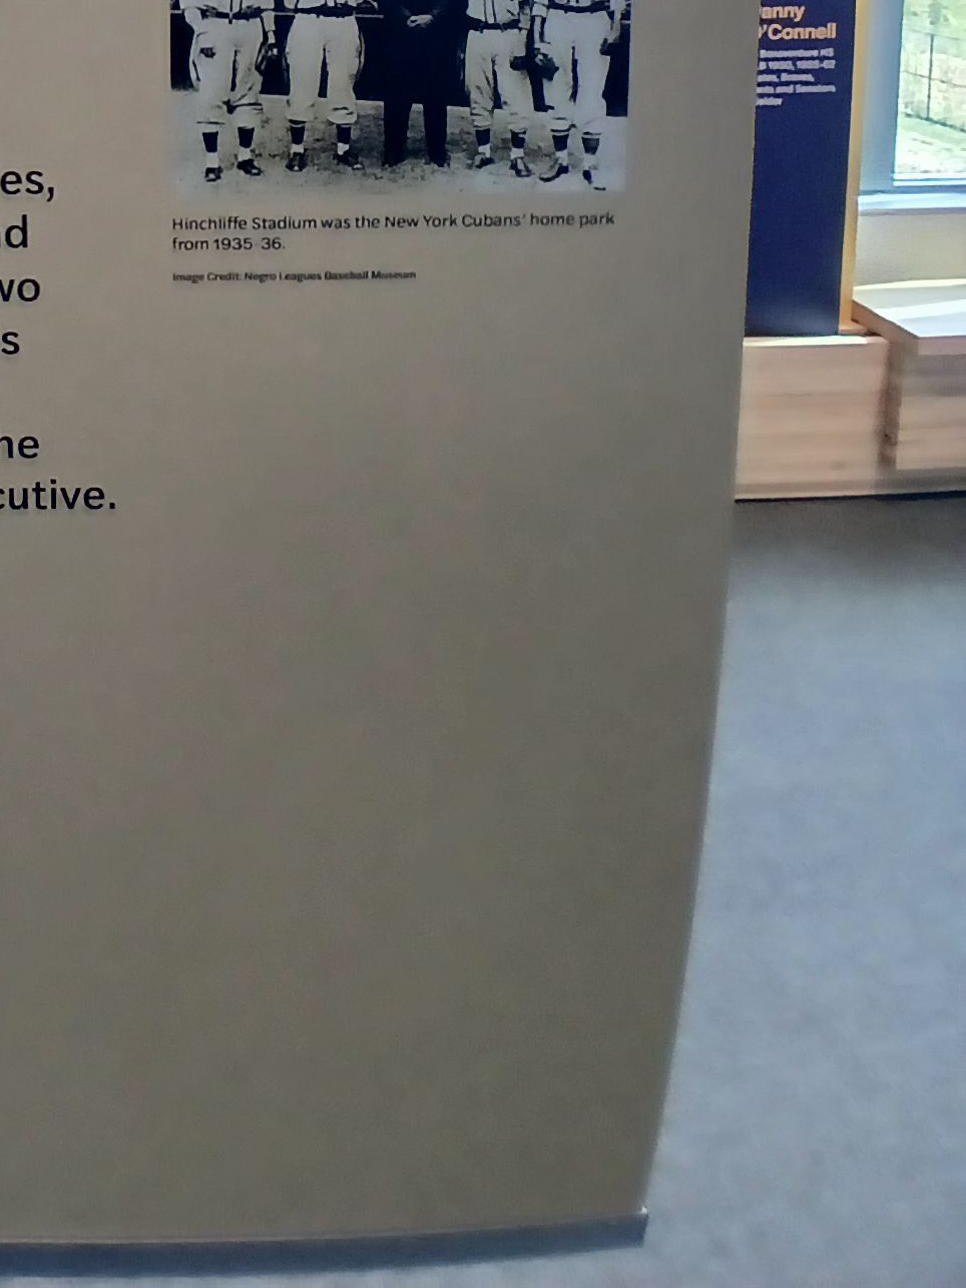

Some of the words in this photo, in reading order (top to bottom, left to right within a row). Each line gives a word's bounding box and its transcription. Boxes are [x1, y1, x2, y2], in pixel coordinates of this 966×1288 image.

[761, 5, 805, 21] anny
[172, 216, 247, 230] Hinchliffe
[252, 216, 317, 230] Stadium
[321, 218, 351, 230] was
[355, 216, 380, 229] the
[385, 216, 419, 228] New
[423, 214, 458, 228] York
[530, 213, 575, 226] home
[579, 212, 614, 228] park
[172, 237, 209, 251] from
